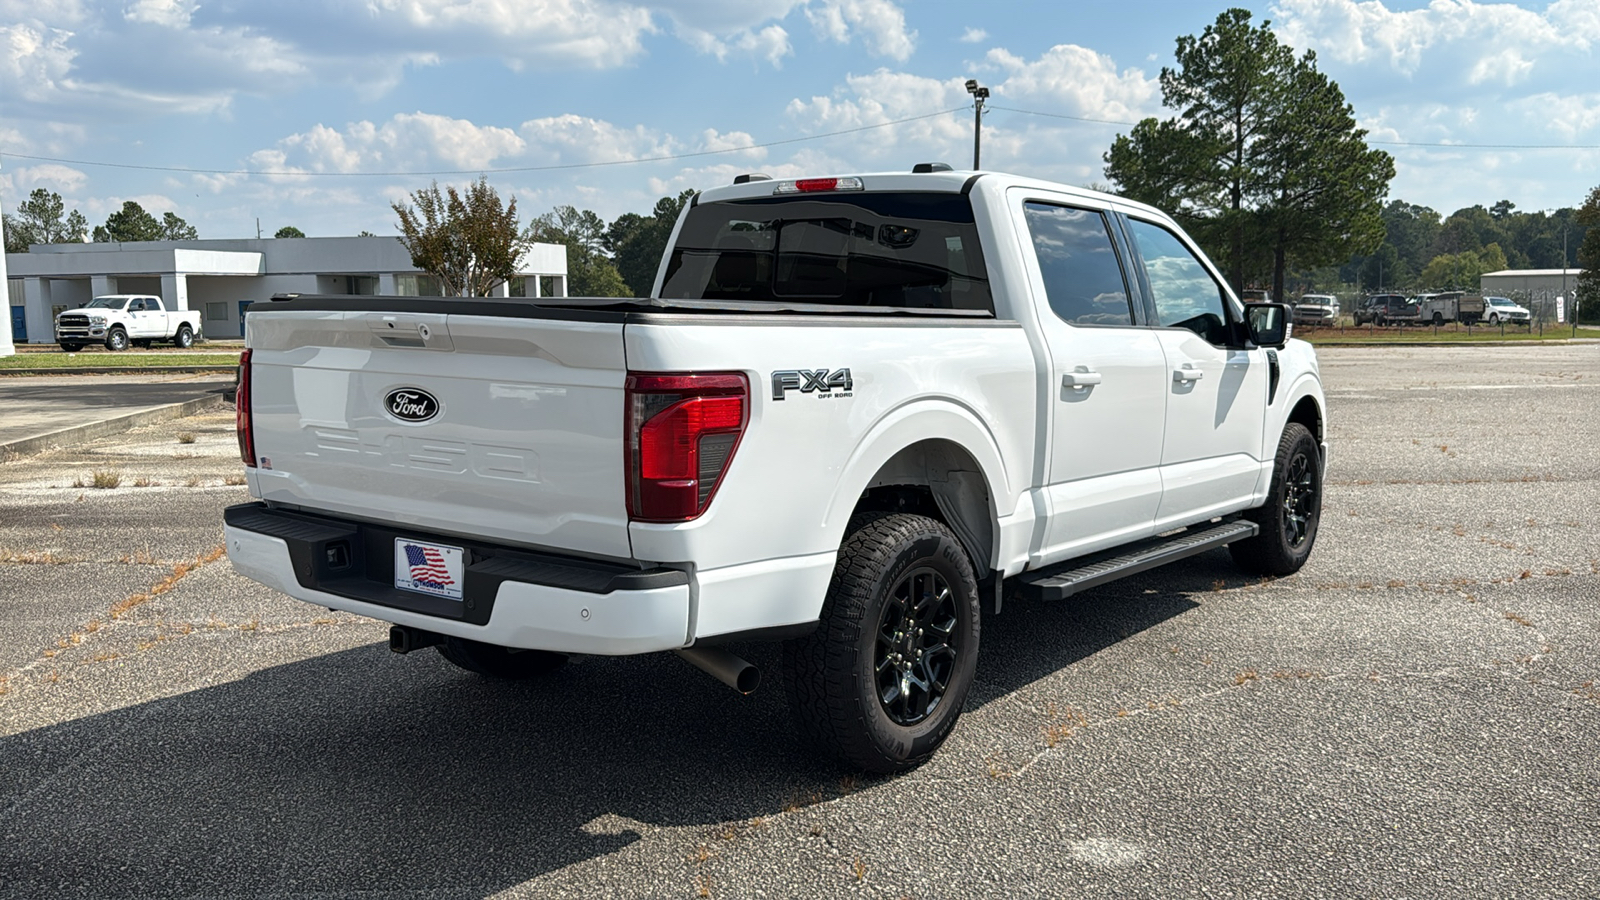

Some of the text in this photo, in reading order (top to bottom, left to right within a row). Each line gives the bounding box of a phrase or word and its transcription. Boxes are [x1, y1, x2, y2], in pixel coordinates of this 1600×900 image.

[771, 368, 853, 401] FX4
[392, 392, 428, 416] Ford
[420, 580, 445, 590] THOMSON
[943, 545, 979, 638] GOODYEAR
